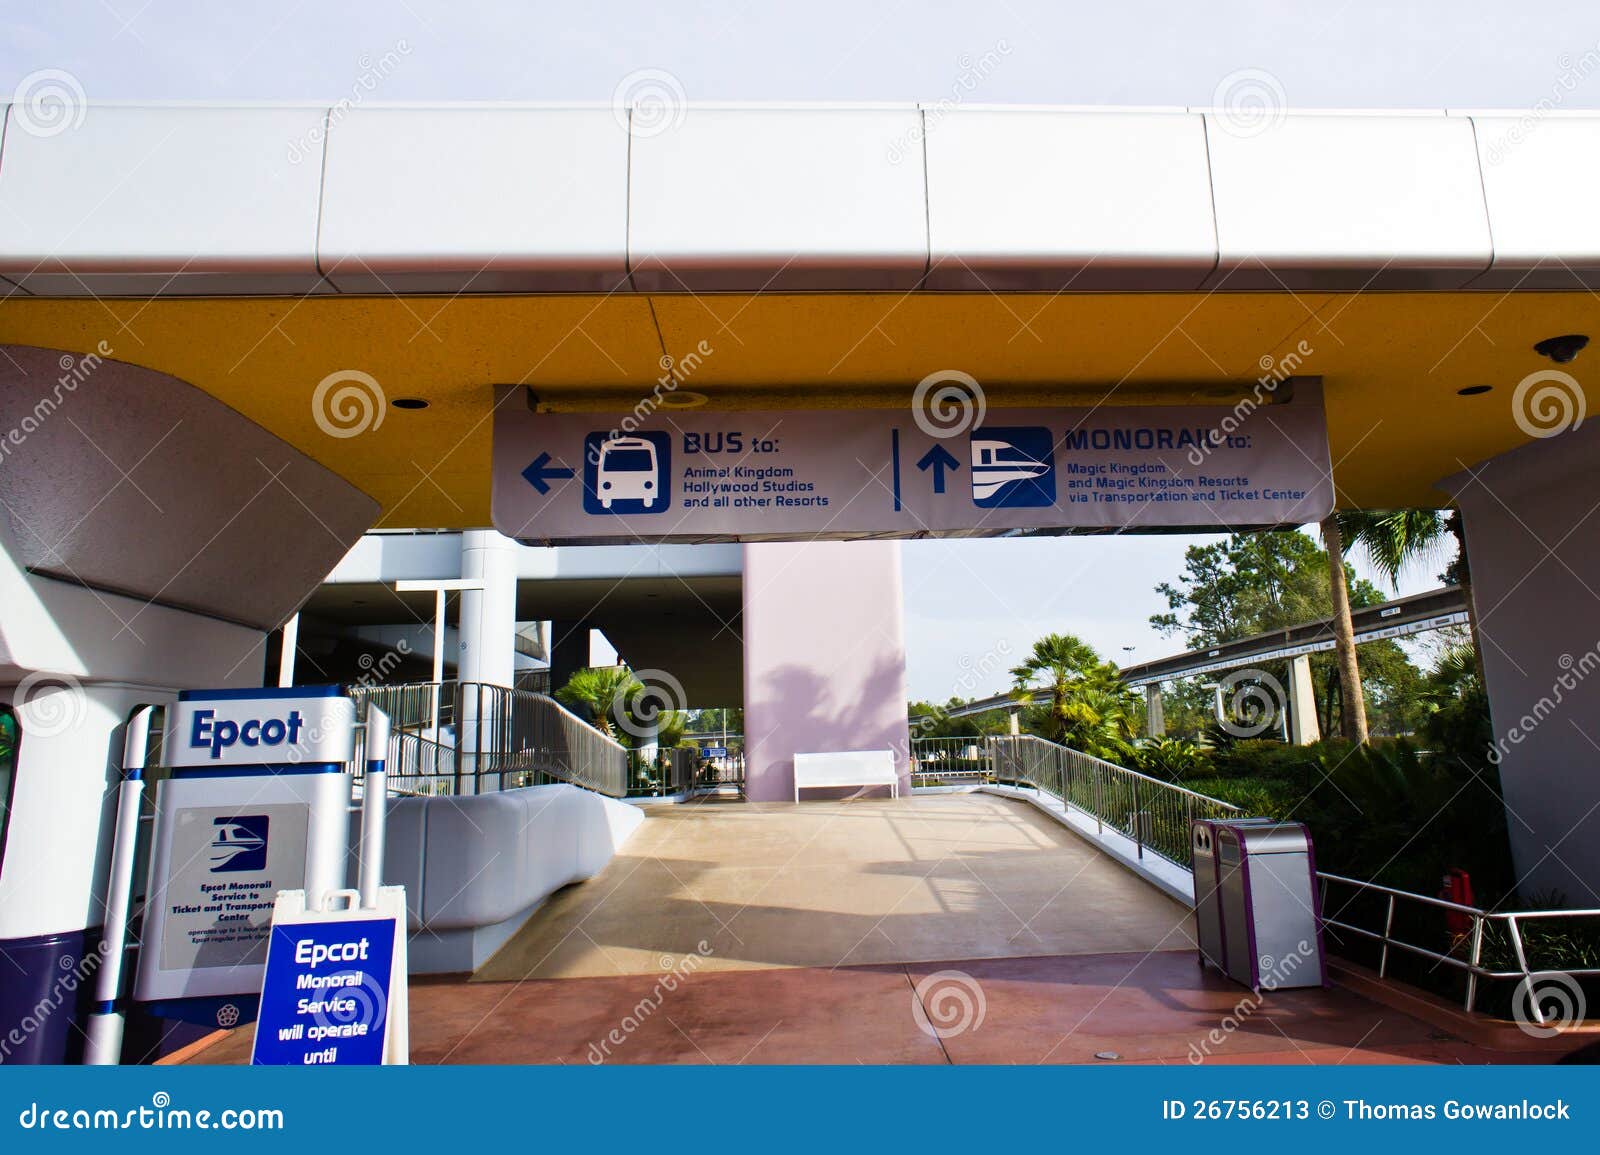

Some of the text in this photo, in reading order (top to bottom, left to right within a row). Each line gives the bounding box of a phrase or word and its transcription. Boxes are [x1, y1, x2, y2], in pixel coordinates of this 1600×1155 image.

[684, 431, 779, 453] BUS to:
[1065, 429, 1252, 450] MONORAIL to:
[684, 467, 793, 479] Animal Kingdom
[1067, 463, 1166, 475] Magic Kingdom
[684, 481, 814, 494] Hollywood Studios
[1068, 476, 1249, 489] and Magic Kingdom Resorts
[684, 496, 829, 507] and all other Resorts
[1069, 488, 1306, 504] via Transportation and Ticket Center
[190, 709, 303, 759] Epcot
[200, 880, 272, 893] Epcot Monorail
[211, 892, 259, 901] Service to
[172, 905, 201, 914] Ticket
[204, 903, 222, 912] and
[218, 913, 250, 921] Center
[294, 938, 369, 968] Epcot
[296, 971, 363, 989] Monorail
[296, 998, 356, 1014] Service
[278, 1022, 368, 1041] will operate
[304, 1047, 337, 1065] until
